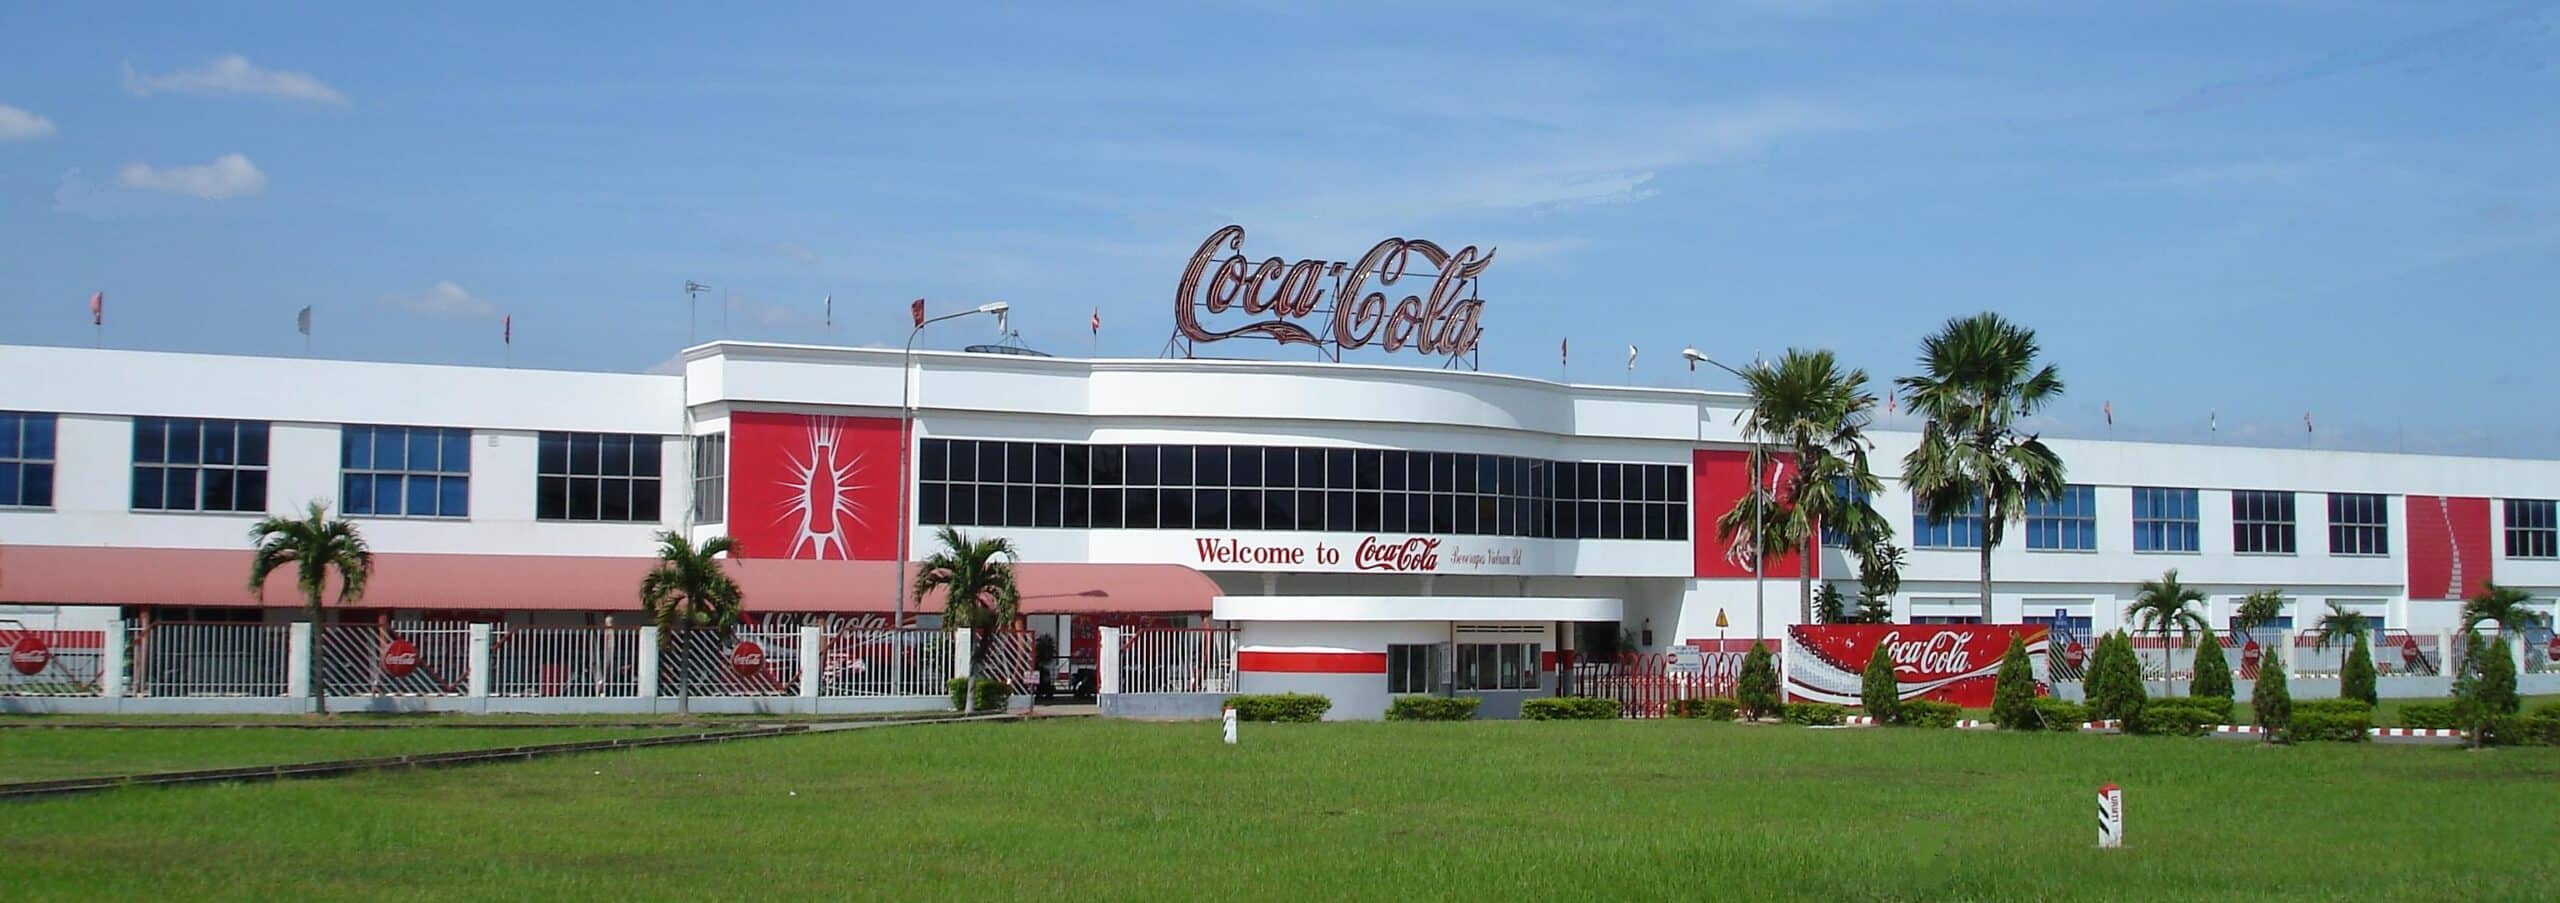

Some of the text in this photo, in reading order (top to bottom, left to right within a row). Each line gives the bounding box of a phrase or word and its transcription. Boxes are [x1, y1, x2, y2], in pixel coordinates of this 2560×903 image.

[1175, 225, 1497, 356] Coca-Cola
[1196, 538, 1304, 564] Welcome
[1316, 541, 1340, 565] to
[1355, 536, 1441, 571] Coca-Cola
